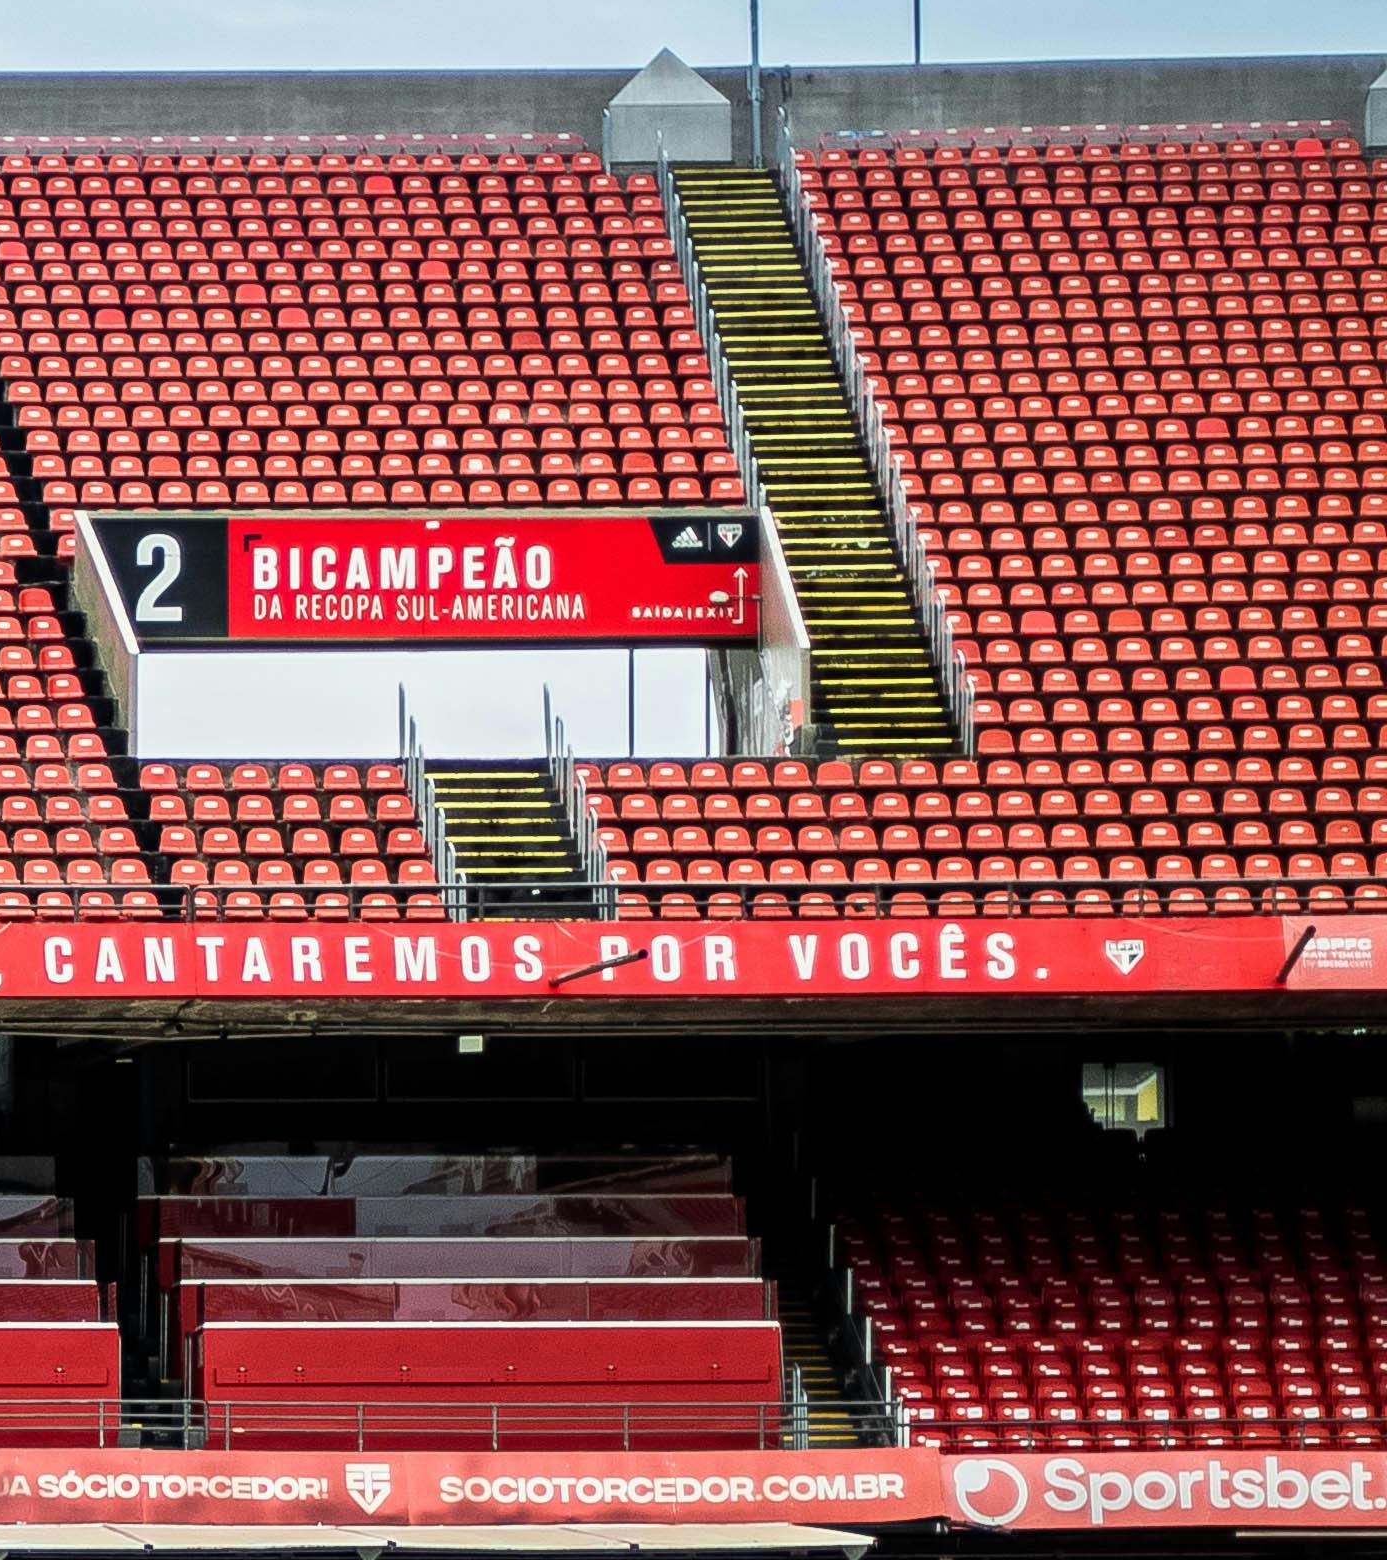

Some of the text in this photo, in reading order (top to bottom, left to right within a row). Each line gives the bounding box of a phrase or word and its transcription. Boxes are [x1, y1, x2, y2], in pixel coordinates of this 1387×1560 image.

[135, 533, 183, 622] 2
[253, 537, 551, 590] BICAMPEÃO
[254, 594, 585, 621] DA RECOPA SUL-AMERICANA
[44, 935, 543, 983] CANTAREMOS
[600, 934, 736, 982] POR
[788, 924, 1049, 981] VOCÊS.
[439, 1473, 905, 1504] SOCIOTORCEDOR.COM.BR
